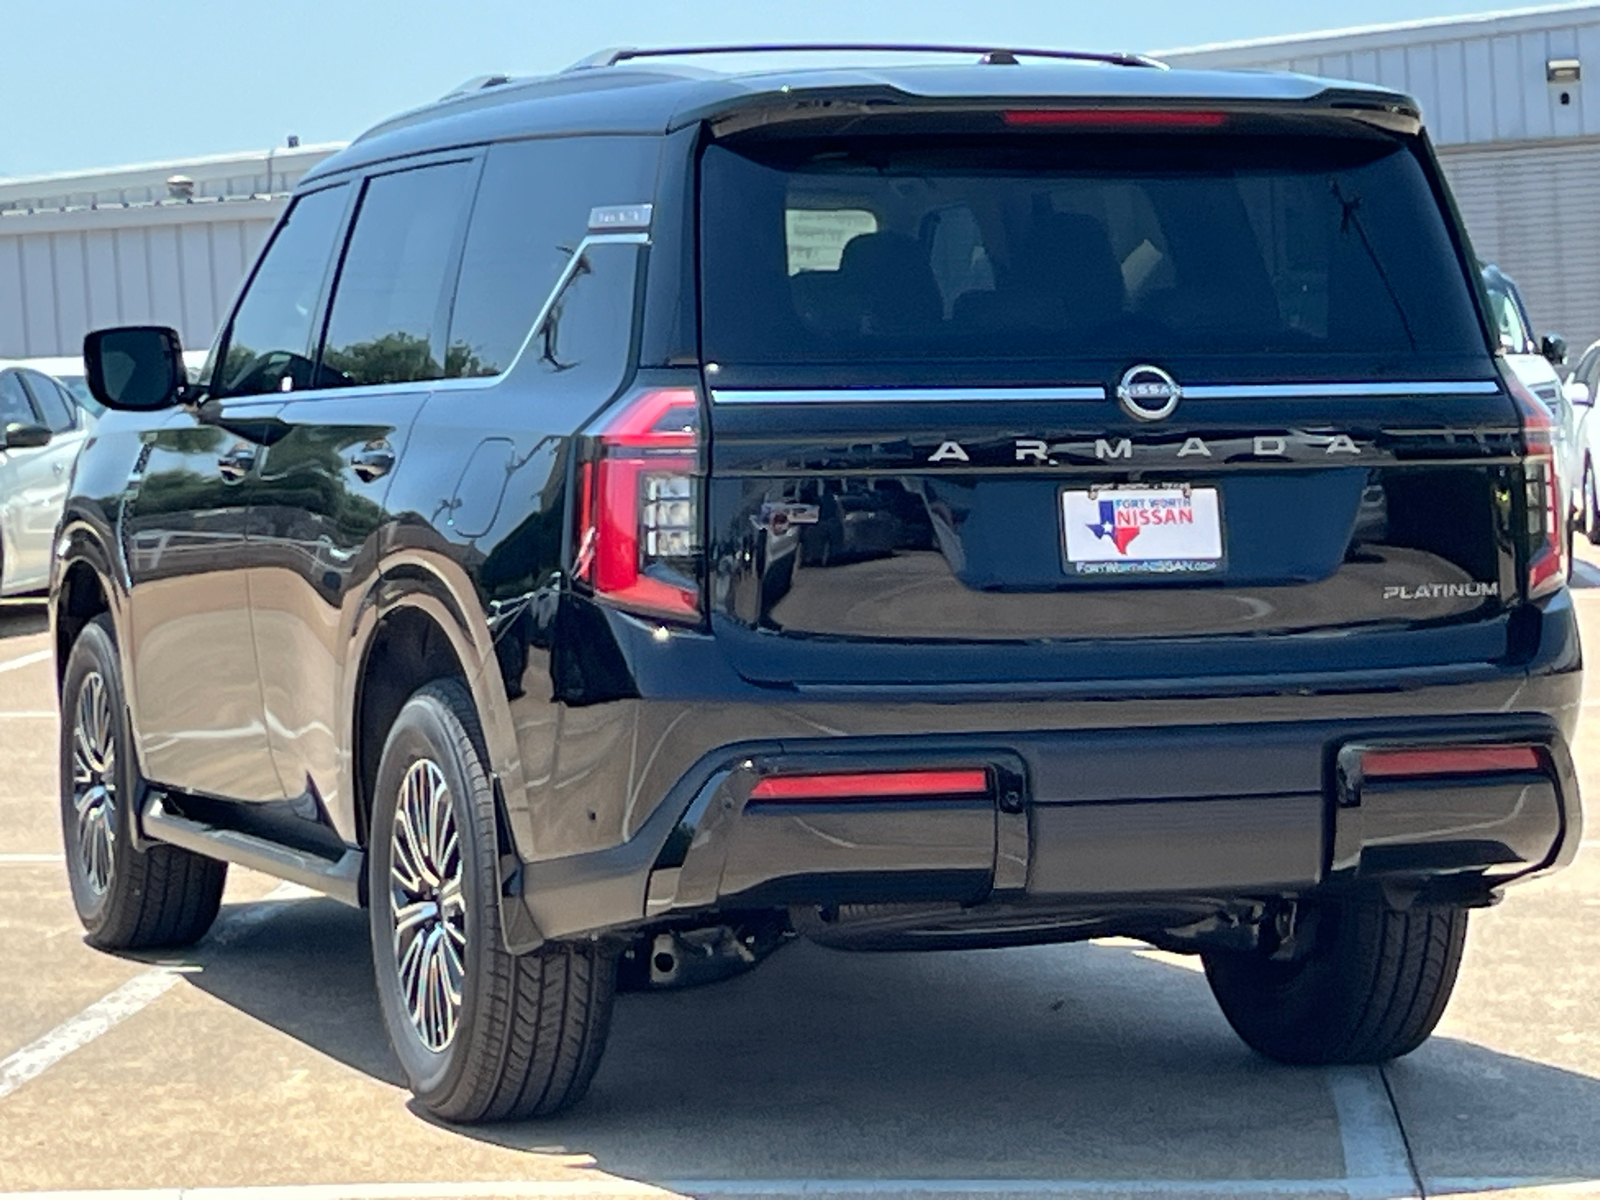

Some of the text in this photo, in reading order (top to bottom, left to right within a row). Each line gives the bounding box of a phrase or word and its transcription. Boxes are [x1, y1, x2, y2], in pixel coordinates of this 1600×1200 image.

[1117, 385, 1181, 397] NISSAN
[928, 433, 1362, 461] ARMADA
[1115, 498, 1191, 509] FORT WORTH
[1117, 508, 1194, 526] NISSAN
[1383, 581, 1499, 600] PLATINUM
